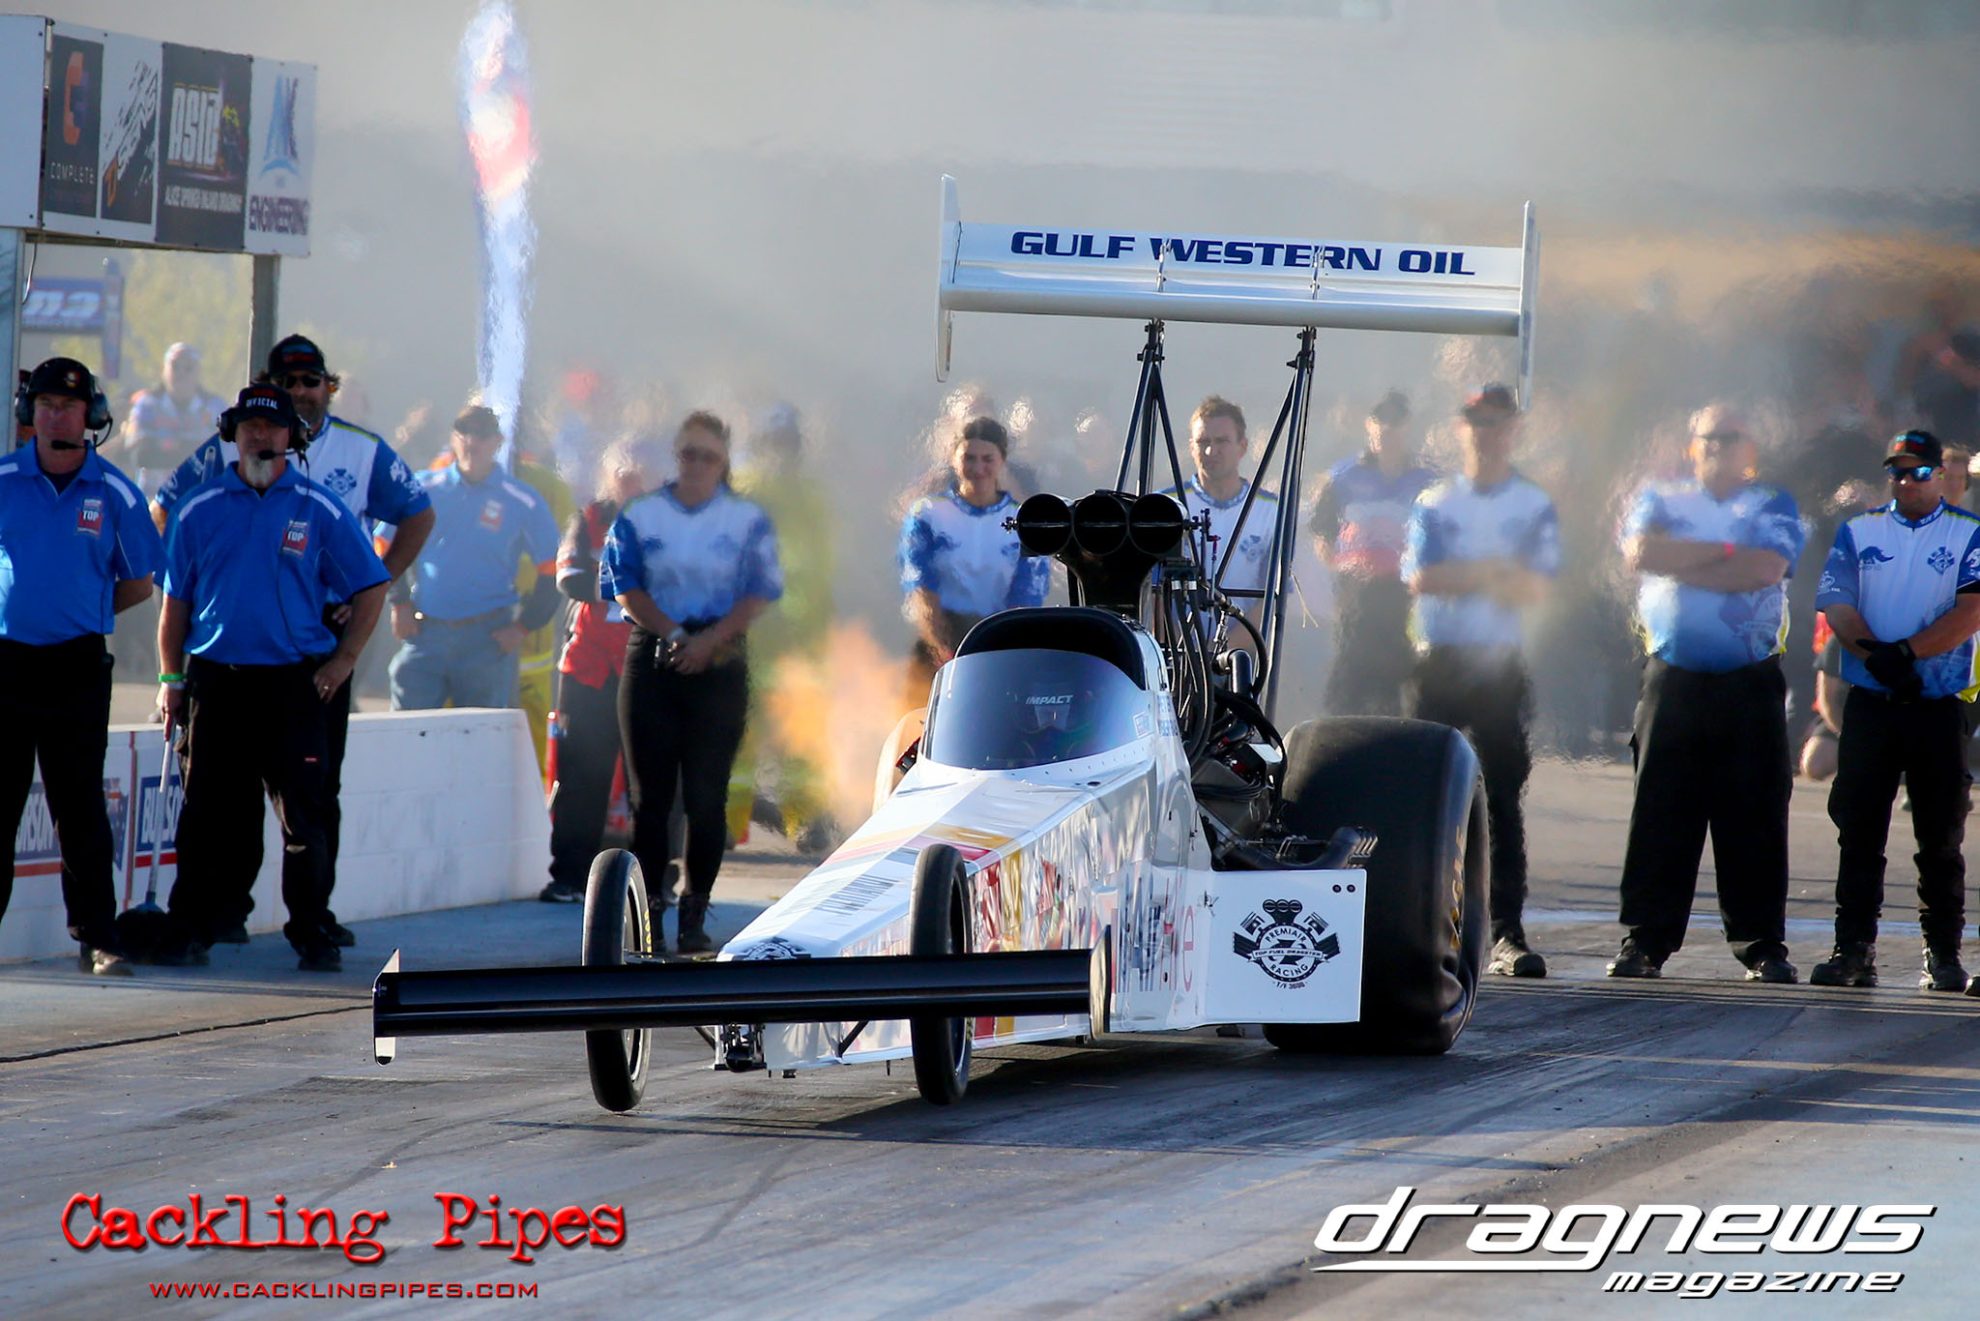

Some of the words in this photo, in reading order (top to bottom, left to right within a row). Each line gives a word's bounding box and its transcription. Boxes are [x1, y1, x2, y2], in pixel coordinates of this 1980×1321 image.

[1011, 231, 1136, 259] GULF
[1151, 238, 1382, 276] WESTERN
[1399, 250, 1475, 275] OIL
[83, 510, 99, 522] TOP
[1025, 694, 1074, 705] IMPACT
[1264, 928, 1307, 942] PREMIAIR
[1270, 963, 1308, 977] RACING
